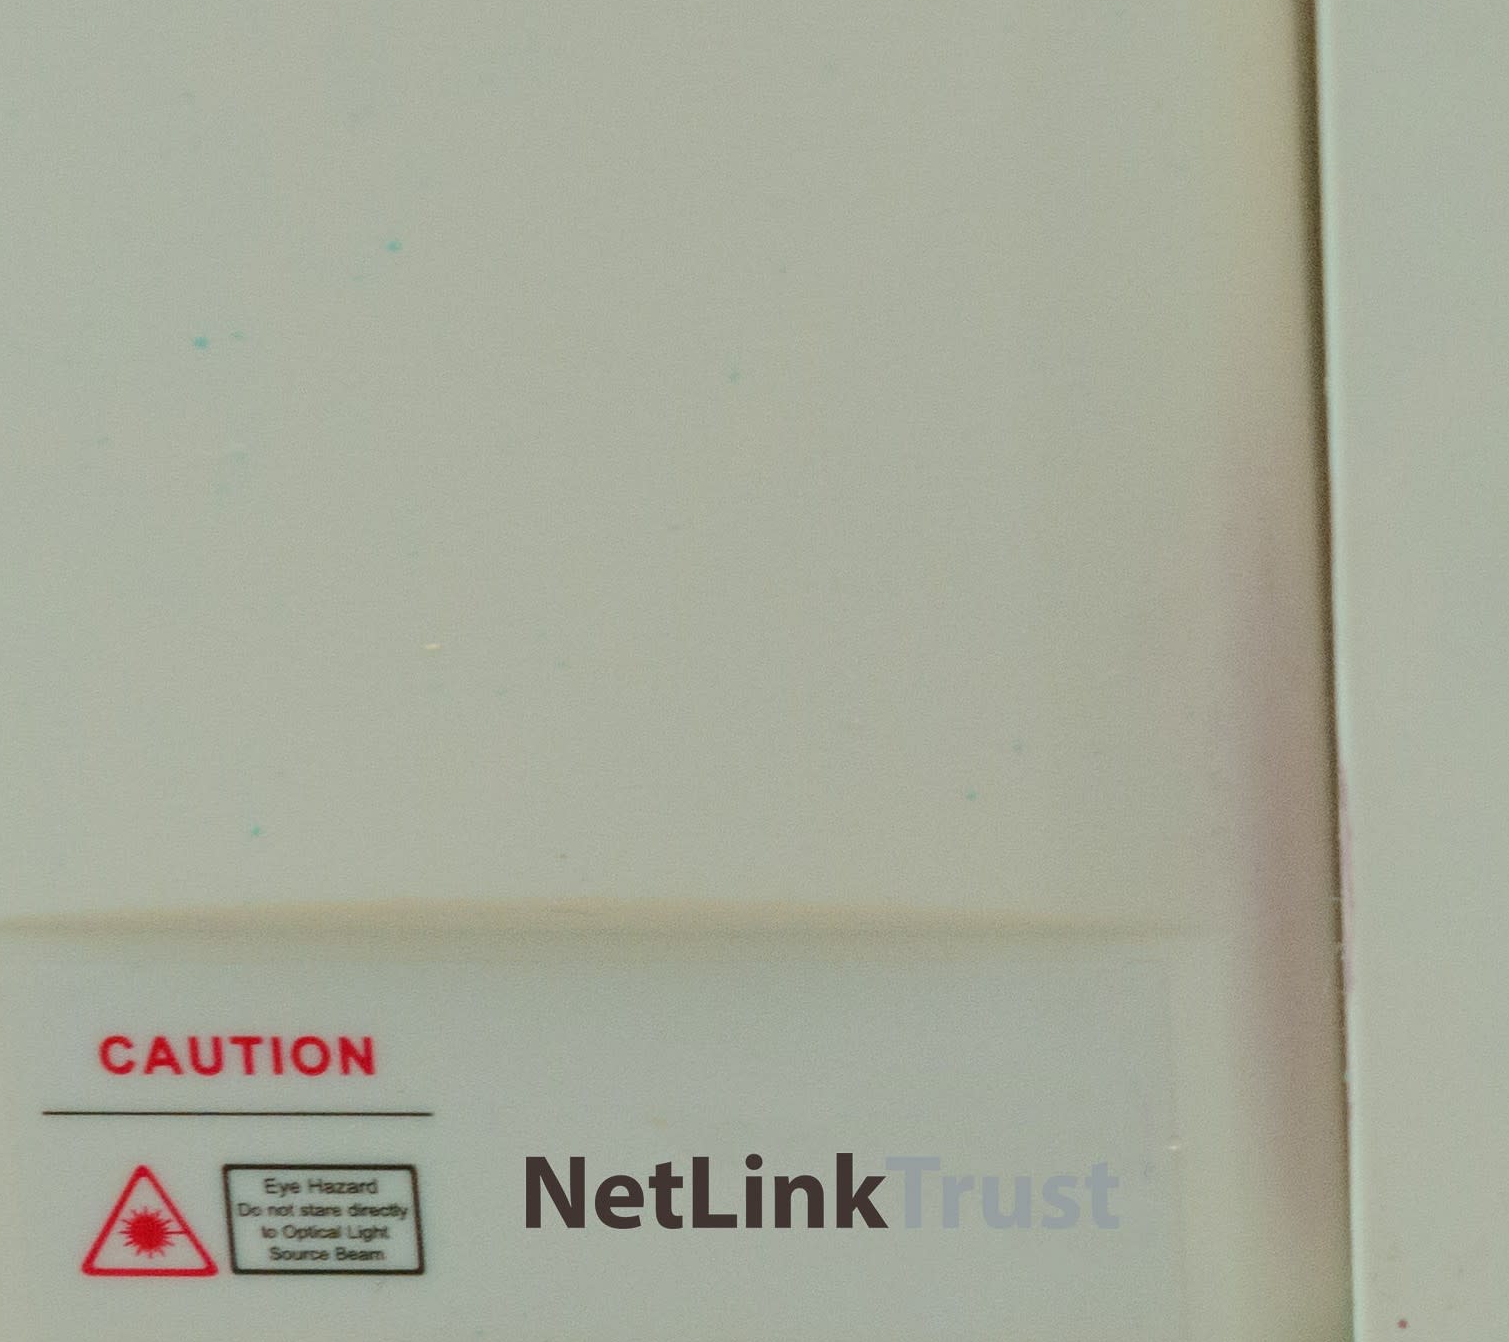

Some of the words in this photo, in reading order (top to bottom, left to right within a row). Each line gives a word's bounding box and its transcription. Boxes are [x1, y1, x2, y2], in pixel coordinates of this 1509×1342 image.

[99, 1035, 376, 1076] CAUTION
[264, 1178, 300, 1197] Eye
[307, 1178, 379, 1194] Hazard
[524, 1152, 1121, 1230] NetLinkTrust
[238, 1202, 262, 1217] Do
[267, 1203, 295, 1217] not
[299, 1204, 342, 1217] stare
[347, 1203, 408, 1220] directly
[261, 1225, 276, 1239] to
[282, 1224, 341, 1241] Optical
[347, 1225, 390, 1242] Light
[269, 1246, 329, 1261] Source
[335, 1246, 385, 1261] Beam
